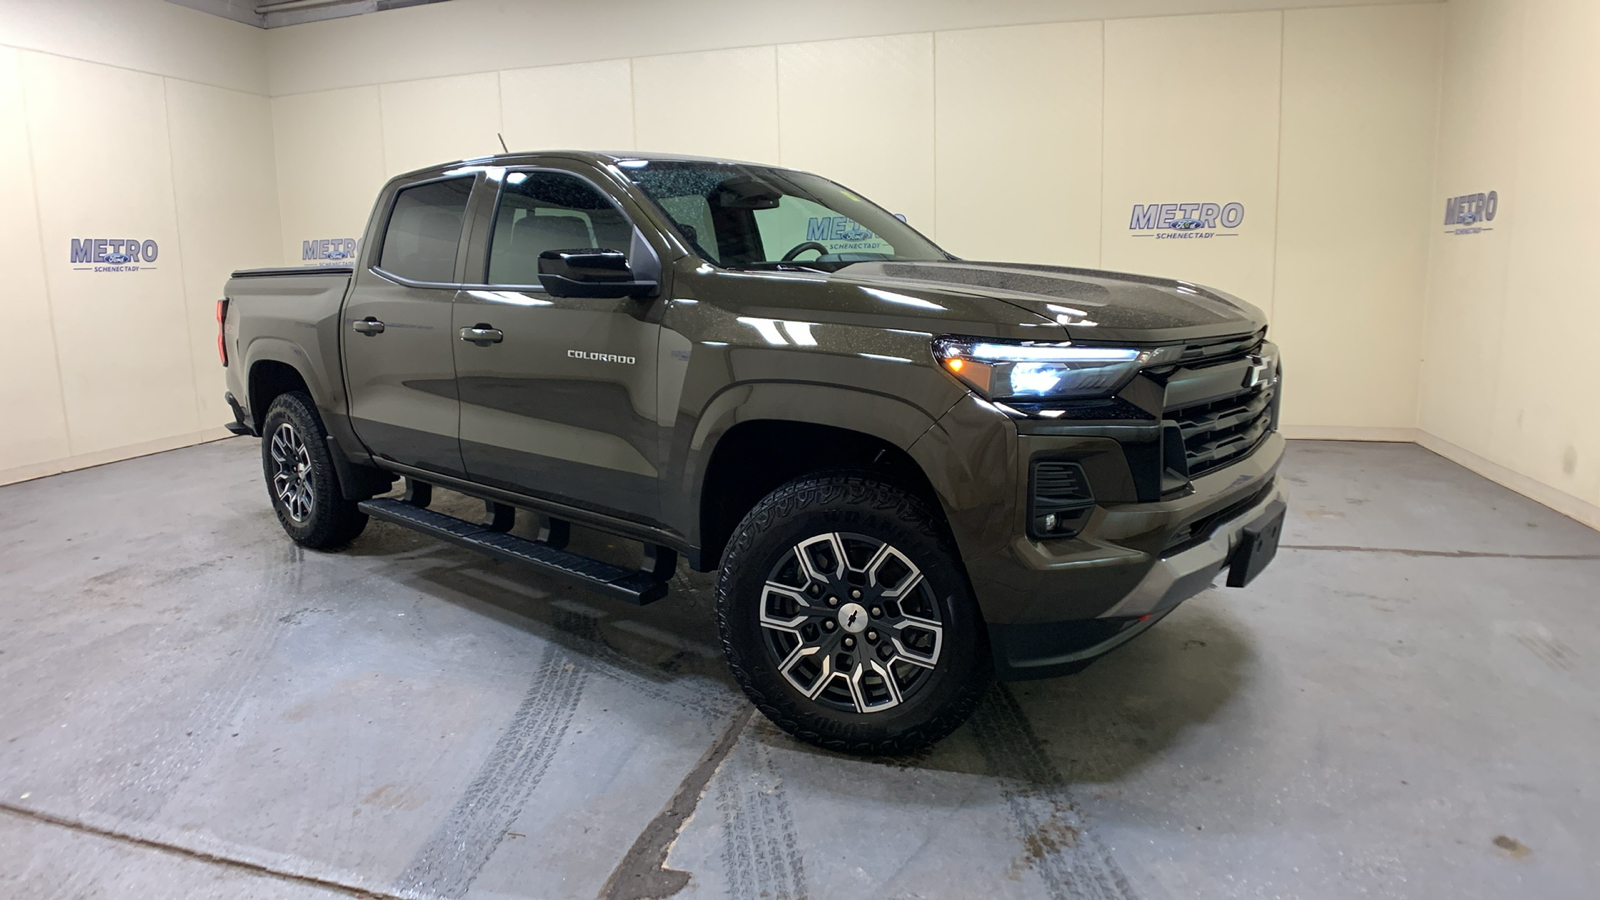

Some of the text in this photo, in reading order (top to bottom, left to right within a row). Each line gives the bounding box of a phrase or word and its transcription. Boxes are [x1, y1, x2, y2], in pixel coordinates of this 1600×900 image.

[1129, 202, 1245, 230] METRO
[1444, 190, 1498, 226] METRO
[70, 238, 159, 263] METRO
[829, 242, 882, 250] SCHENECTADY
[567, 349, 636, 365] COLORADO
